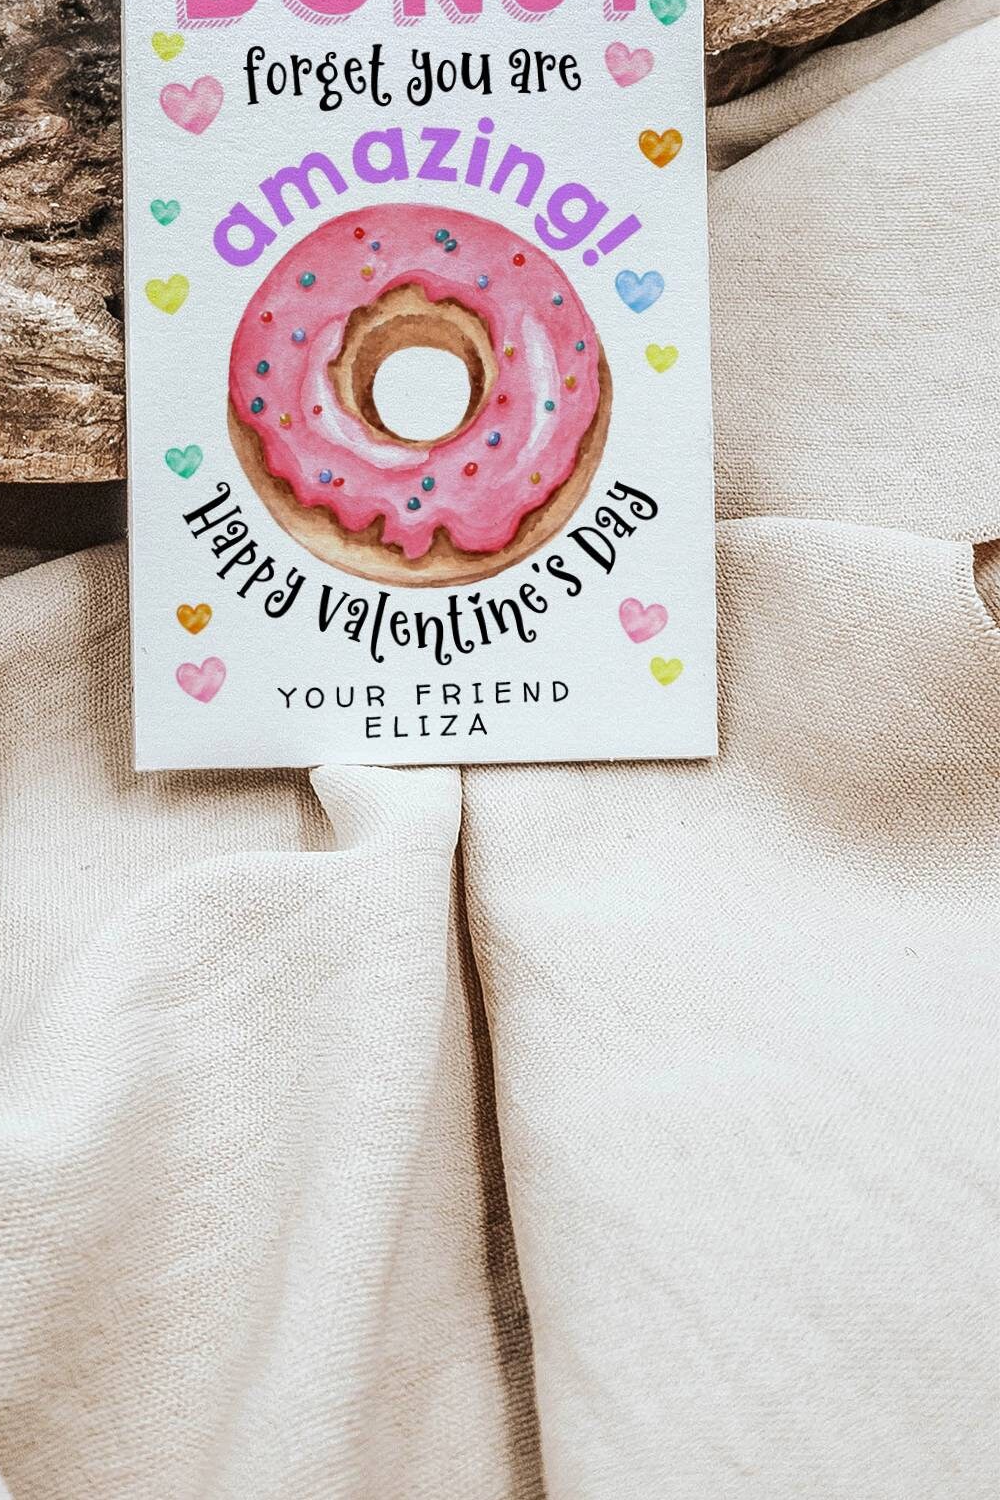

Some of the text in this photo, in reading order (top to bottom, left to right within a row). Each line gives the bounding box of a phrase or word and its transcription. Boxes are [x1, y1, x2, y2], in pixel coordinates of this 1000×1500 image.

[242, 43, 583, 112] forget you are
[211, 116, 643, 267] amazing!
[181, 481, 307, 620] Happy
[566, 479, 659, 575] Day
[276, 680, 571, 710] YOUR FRIEND
[363, 713, 489, 739] ELIZA
